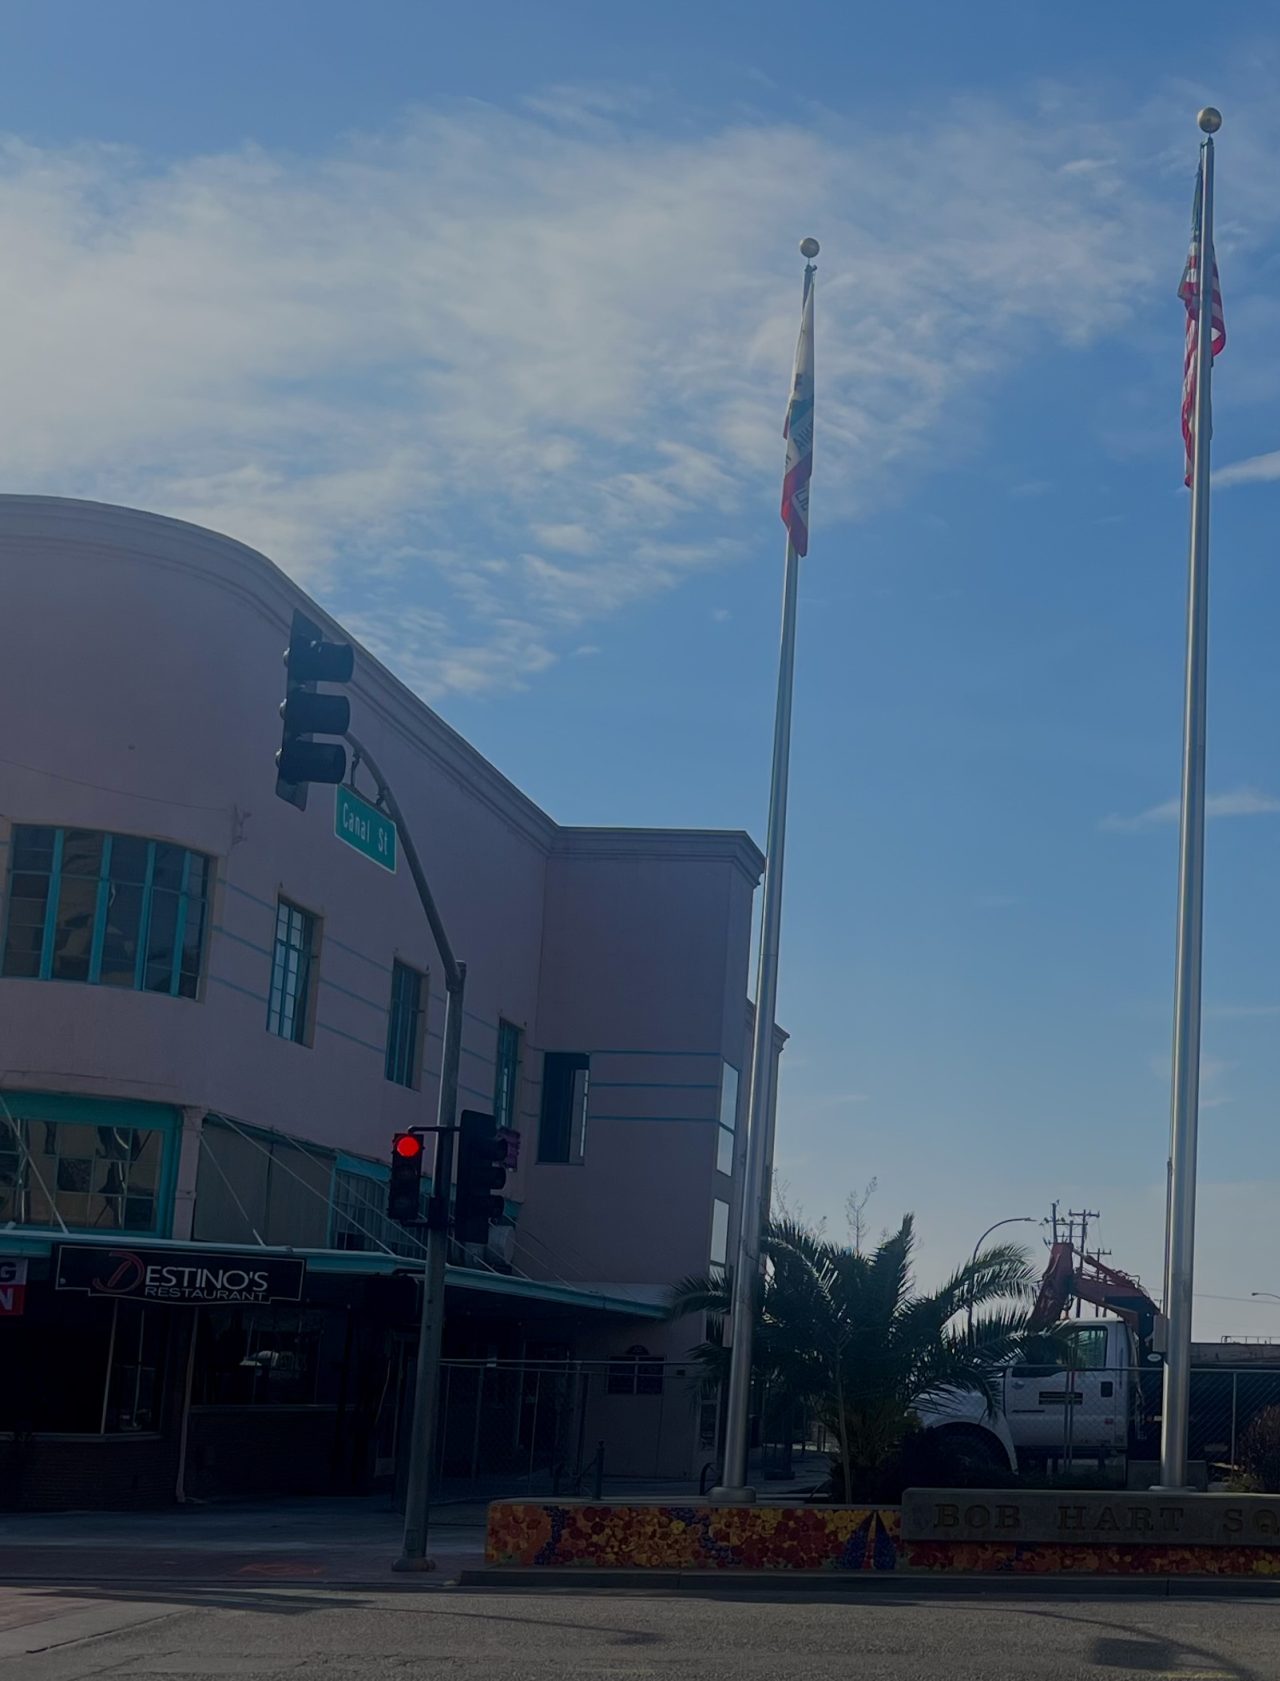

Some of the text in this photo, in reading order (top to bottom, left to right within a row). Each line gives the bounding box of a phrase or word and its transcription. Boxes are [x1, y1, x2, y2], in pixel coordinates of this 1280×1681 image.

[342, 801, 389, 857] Canal St
[92, 1250, 269, 1293] DESTINO'S
[144, 1286, 268, 1301] RESTAURANT
[933, 1503, 1021, 1529] BOB
[1057, 1505, 1184, 1532] HART
